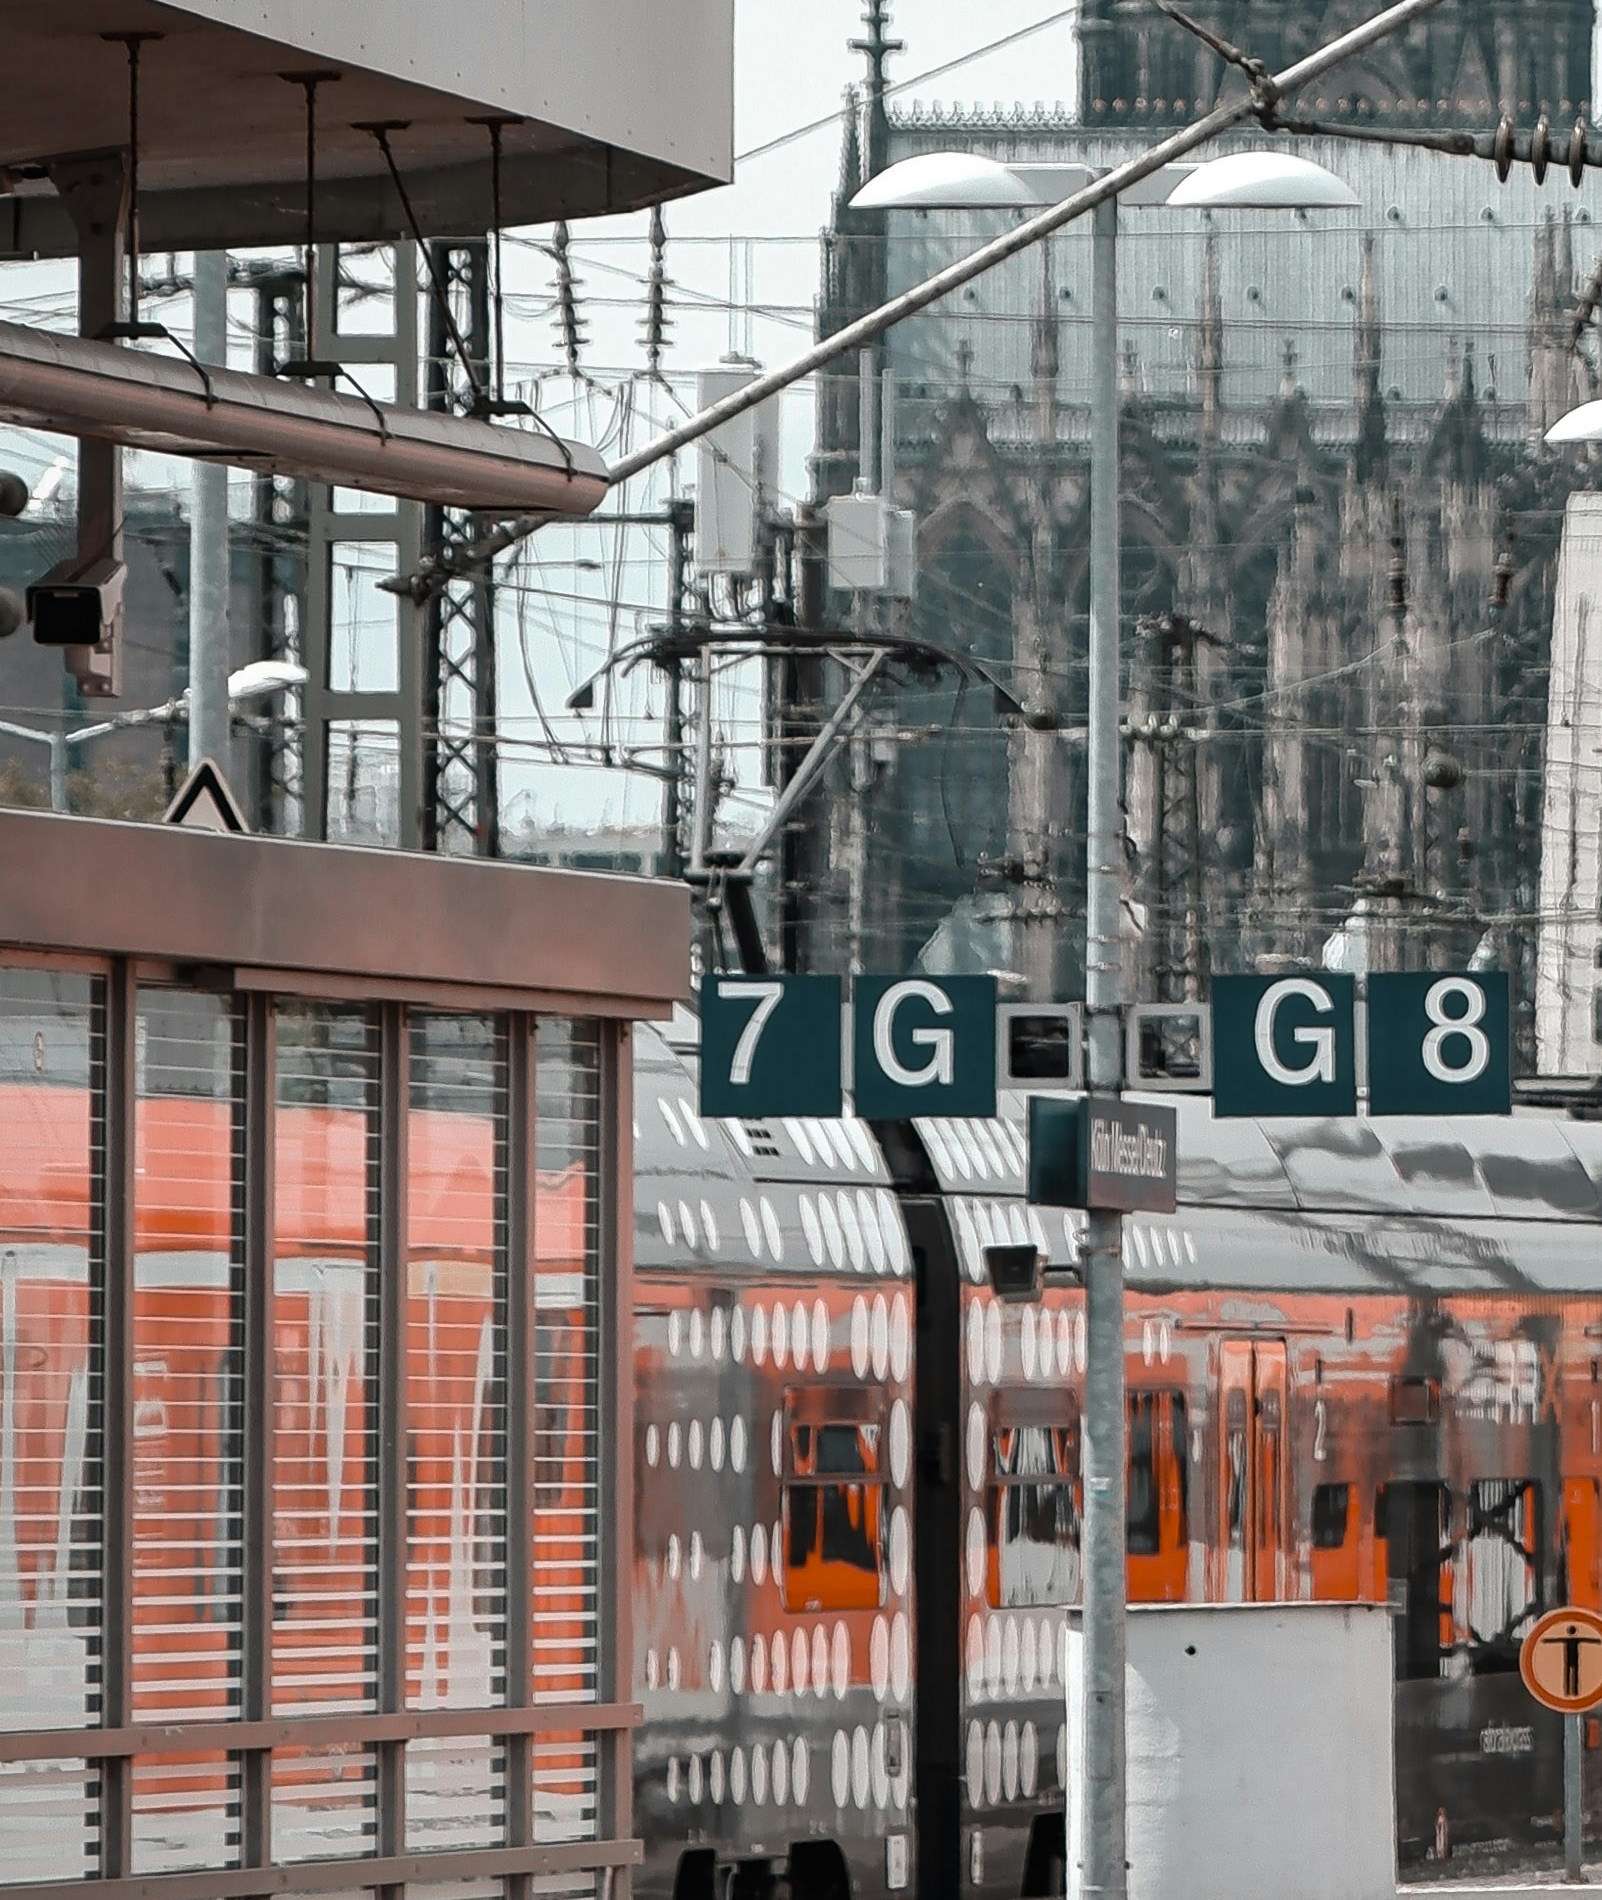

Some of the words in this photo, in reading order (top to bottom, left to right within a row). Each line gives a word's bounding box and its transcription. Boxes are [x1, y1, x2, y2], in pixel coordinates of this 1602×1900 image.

[717, 981, 785, 1085] 7
[872, 980, 955, 1087] G
[1254, 978, 1337, 1087] G
[1422, 976, 1491, 1085] 8
[1314, 1400, 1327, 1461] 2
